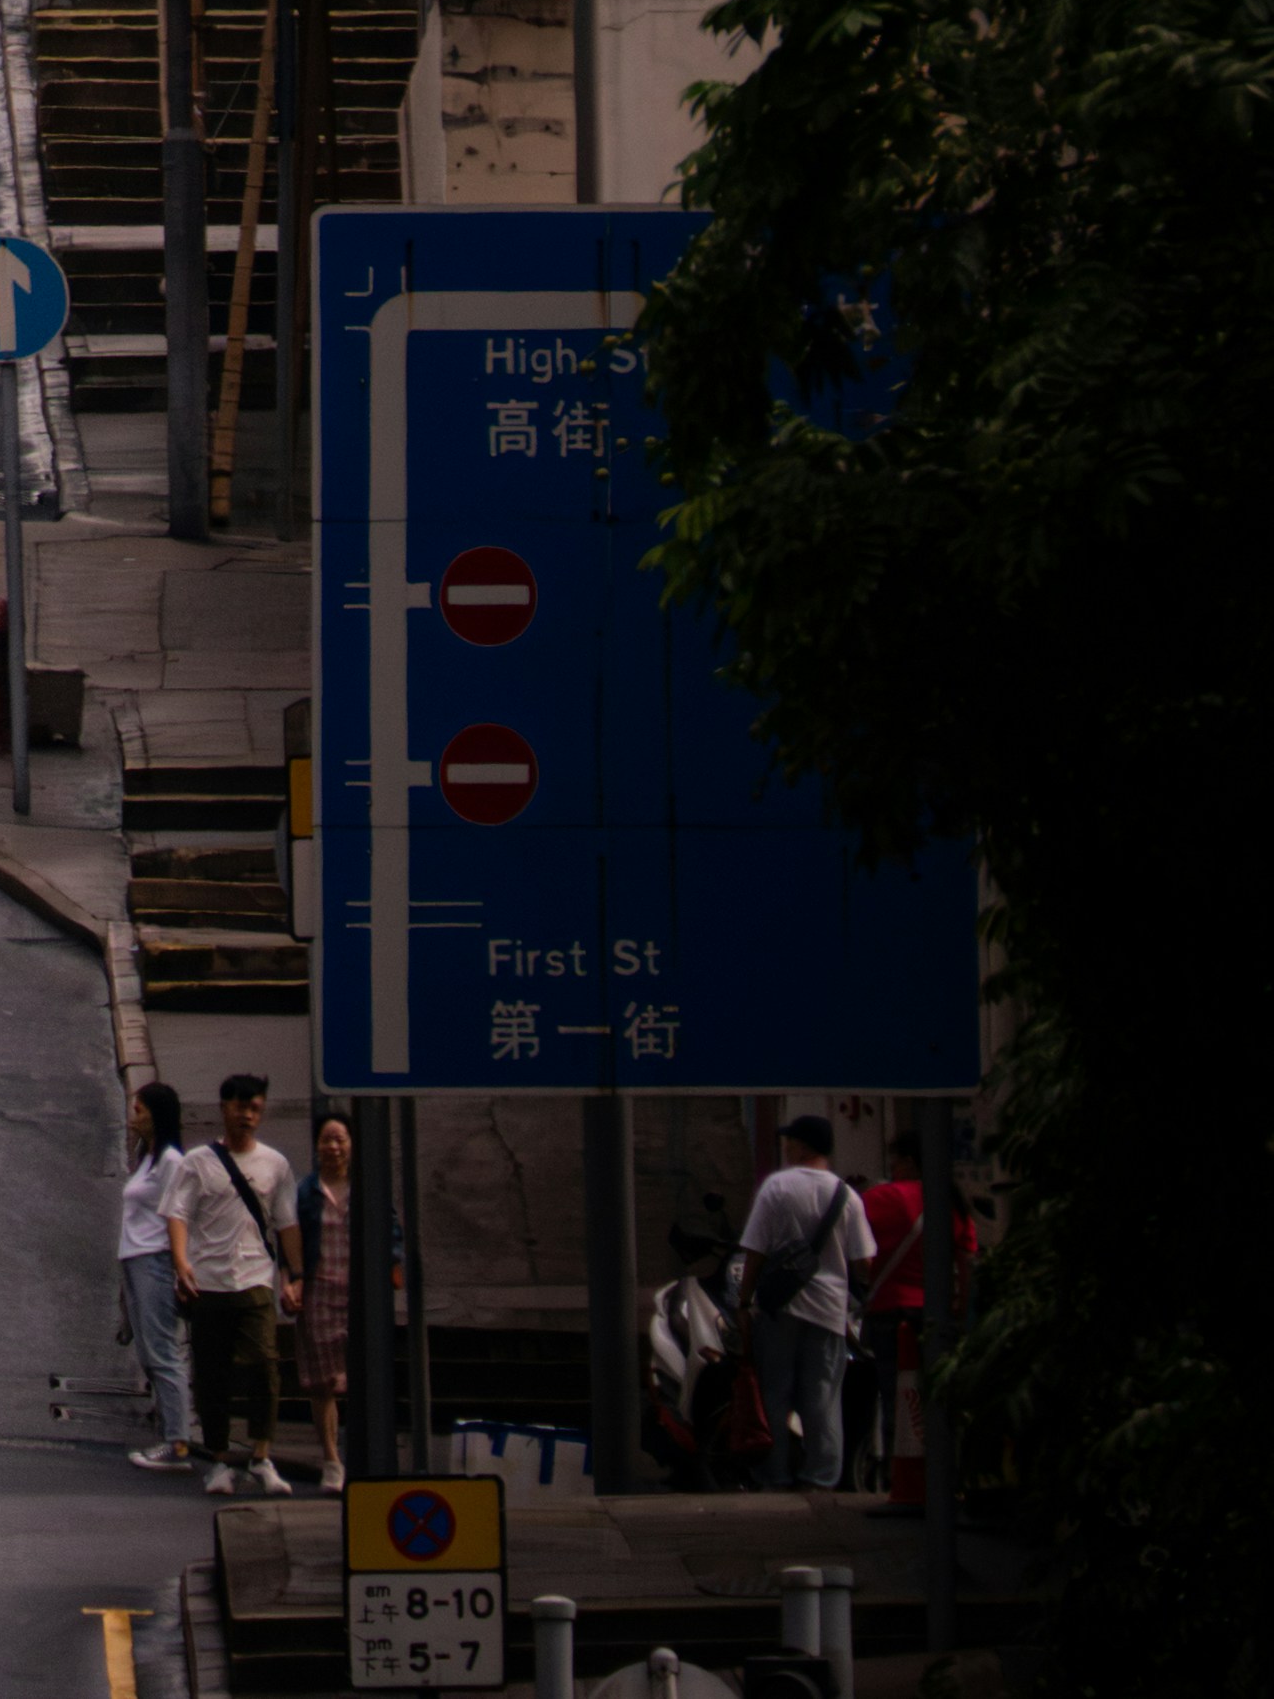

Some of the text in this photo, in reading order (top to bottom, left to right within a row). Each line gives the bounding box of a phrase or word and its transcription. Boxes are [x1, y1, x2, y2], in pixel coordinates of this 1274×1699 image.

[485, 338, 578, 384] High
[486, 398, 611, 458] 高街
[488, 941, 661, 977] First St
[488, 999, 680, 1062] 第一街
[357, 1587, 495, 1624] 上午 8-10
[366, 1585, 391, 1598] am
[359, 1641, 481, 1676] 下午 5-7
[365, 1637, 391, 1655] pm
